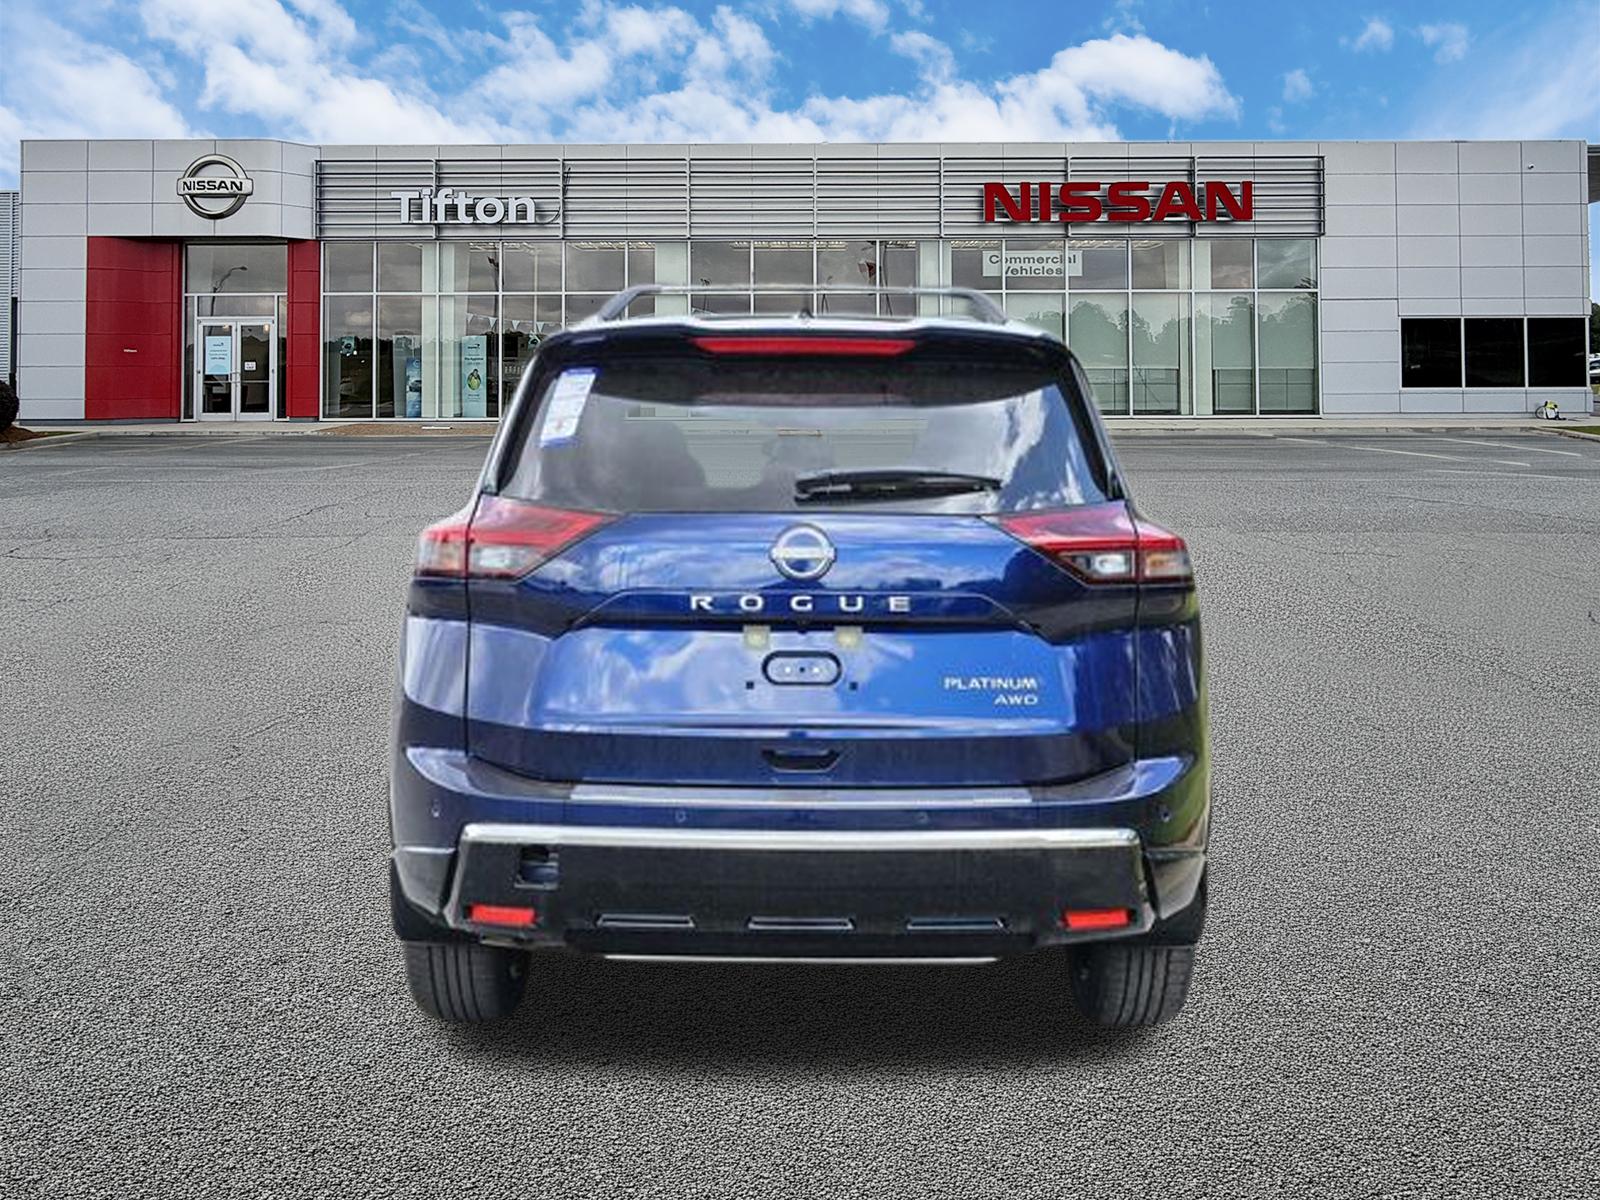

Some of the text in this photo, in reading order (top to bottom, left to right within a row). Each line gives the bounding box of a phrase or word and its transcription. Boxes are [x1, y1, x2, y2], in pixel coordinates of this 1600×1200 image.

[182, 180, 243, 191] NISSAN
[391, 188, 536, 224] Tifton
[983, 181, 1253, 222] NISSAN
[690, 595, 911, 613] ROGUE
[943, 677, 1038, 690] PLATINUM
[994, 694, 1038, 705] AWD
